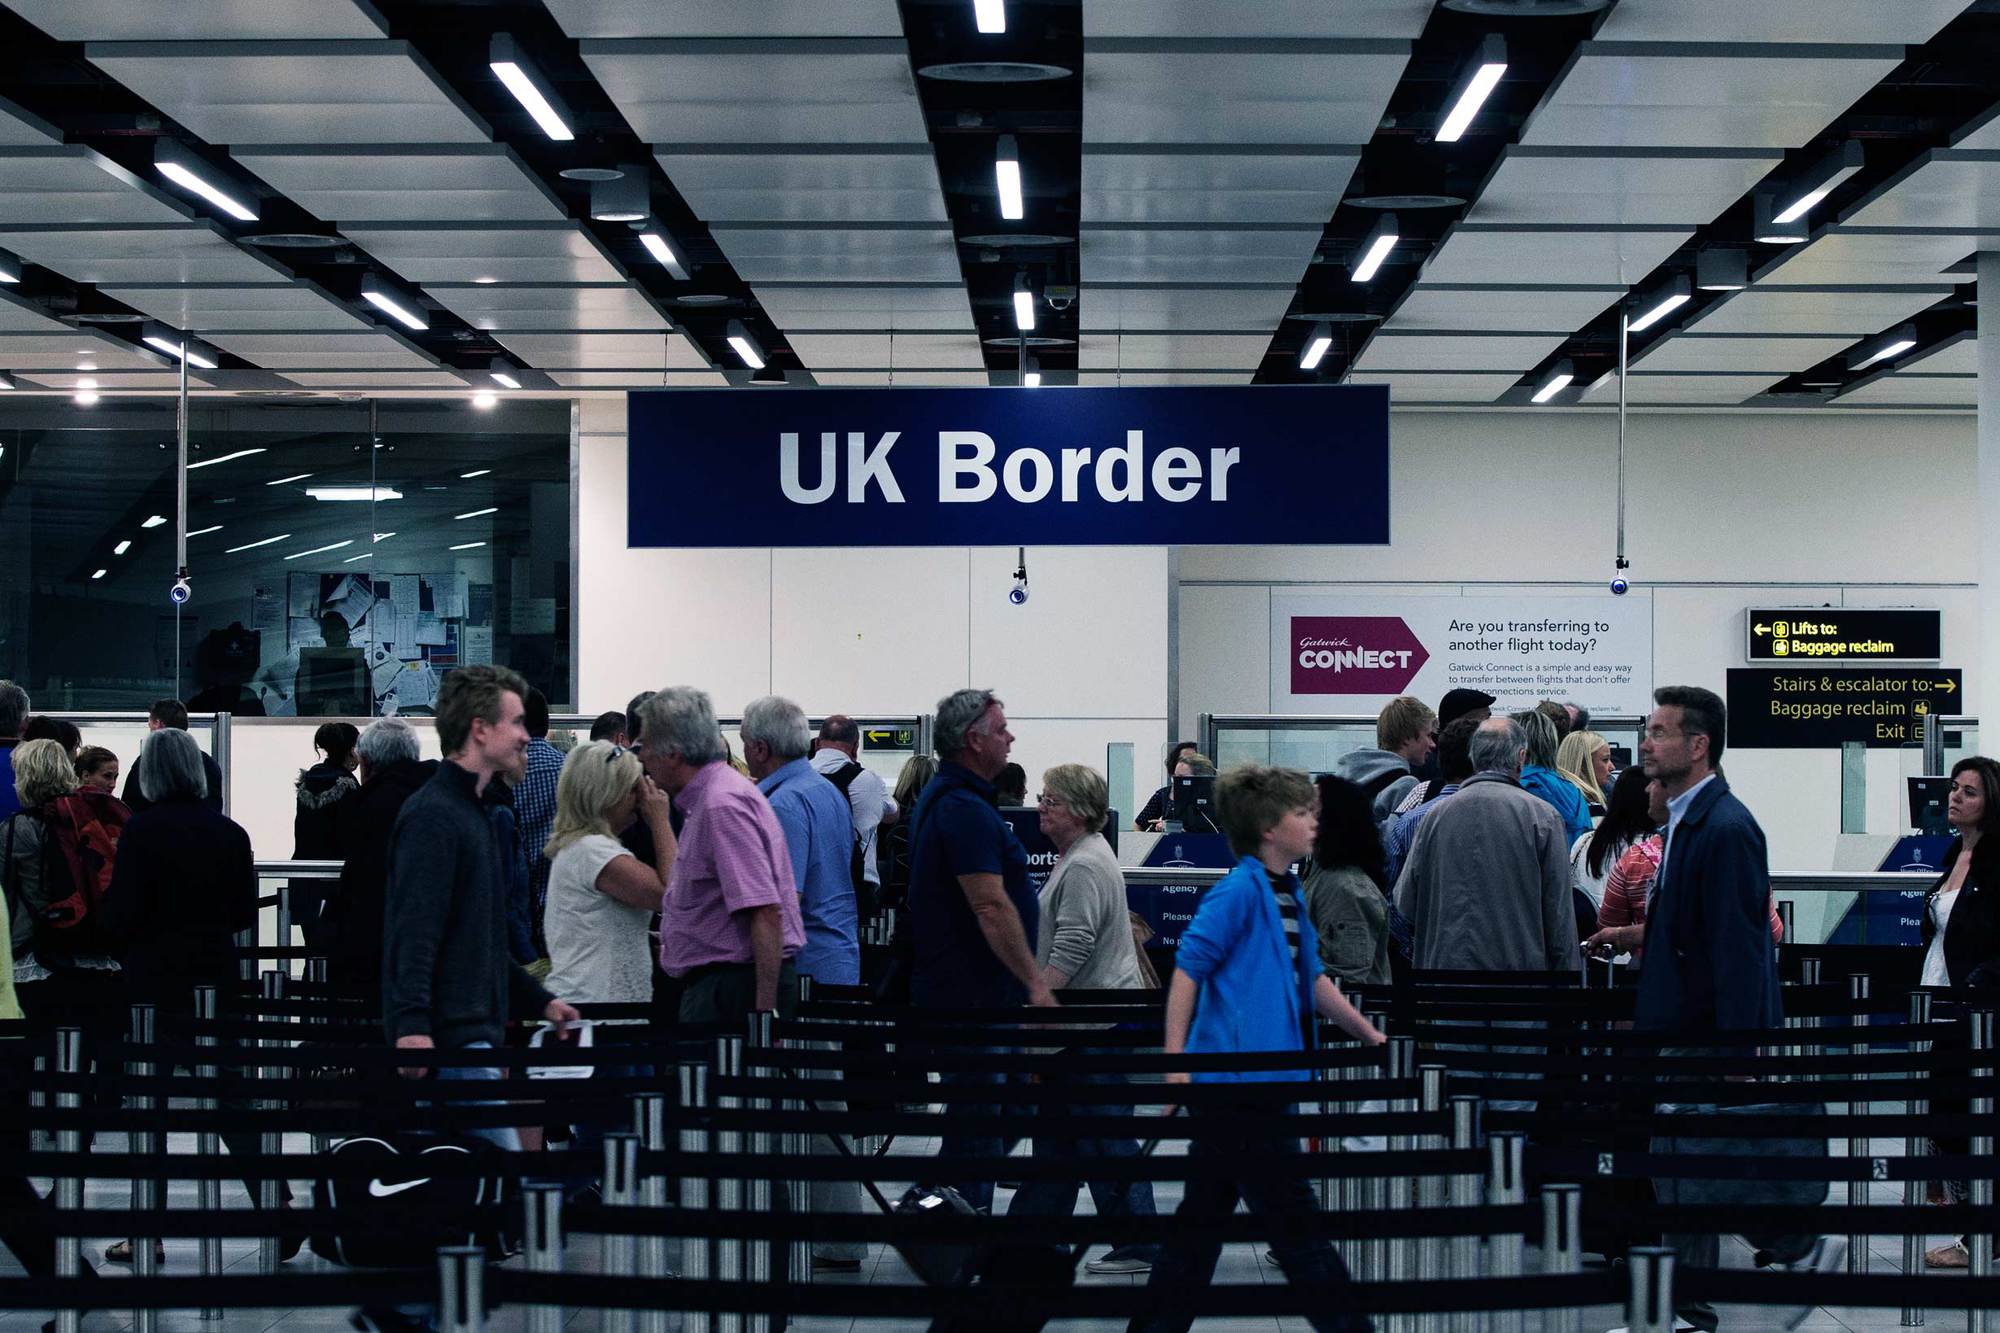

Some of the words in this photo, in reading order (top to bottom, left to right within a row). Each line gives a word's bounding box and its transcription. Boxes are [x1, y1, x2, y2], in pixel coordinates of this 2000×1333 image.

[780, 432, 905, 504] UK
[938, 430, 1240, 503] Border
[1449, 619, 1474, 632] Are
[1478, 622, 1504, 635] you
[1508, 619, 1590, 635] transferring
[1594, 621, 1609, 632] to
[1792, 622, 1818, 634] Lifts
[1820, 623, 1837, 634] to:
[1300, 637, 1352, 649] Gatwick
[1449, 638, 1503, 651] another
[1508, 638, 1544, 654] flight
[1548, 638, 1597, 654] today?
[1792, 640, 1846, 655] Baggage
[1849, 640, 1894, 652] reclaim
[1299, 645, 1413, 673] CONNECT
[1449, 663, 1484, 672] Gatwick
[1486, 663, 1523, 672] Connect
[1526, 663, 1532, 672] is
[1543, 664, 1571, 674] simple
[1574, 664, 1590, 672] and
[1593, 665, 1612, 674] easy
[1615, 665, 1632, 674] way
[1460, 675, 1493, 683] transfer
[1496, 675, 1534, 683] between
[1537, 675, 1563, 685] flights
[1566, 675, 1582, 683] that
[1585, 675, 1608, 683] don't
[1610, 675, 1631, 683] offer
[1773, 677, 1816, 691] Stairs
[1820, 677, 1832, 691] &
[1836, 676, 1907, 691] escalator
[1912, 678, 1933, 691] to:
[1537, 687, 1569, 695] service.
[1771, 701, 1842, 719] Baggage
[1847, 700, 1905, 715] reclaim
[1876, 723, 1905, 738] Exit
[1026, 851, 1060, 865] orts
[1163, 885, 1198, 893] Agency
[1163, 912, 1192, 920] Please
[1901, 917, 1920, 926] Plea
[1163, 937, 1174, 945] No
